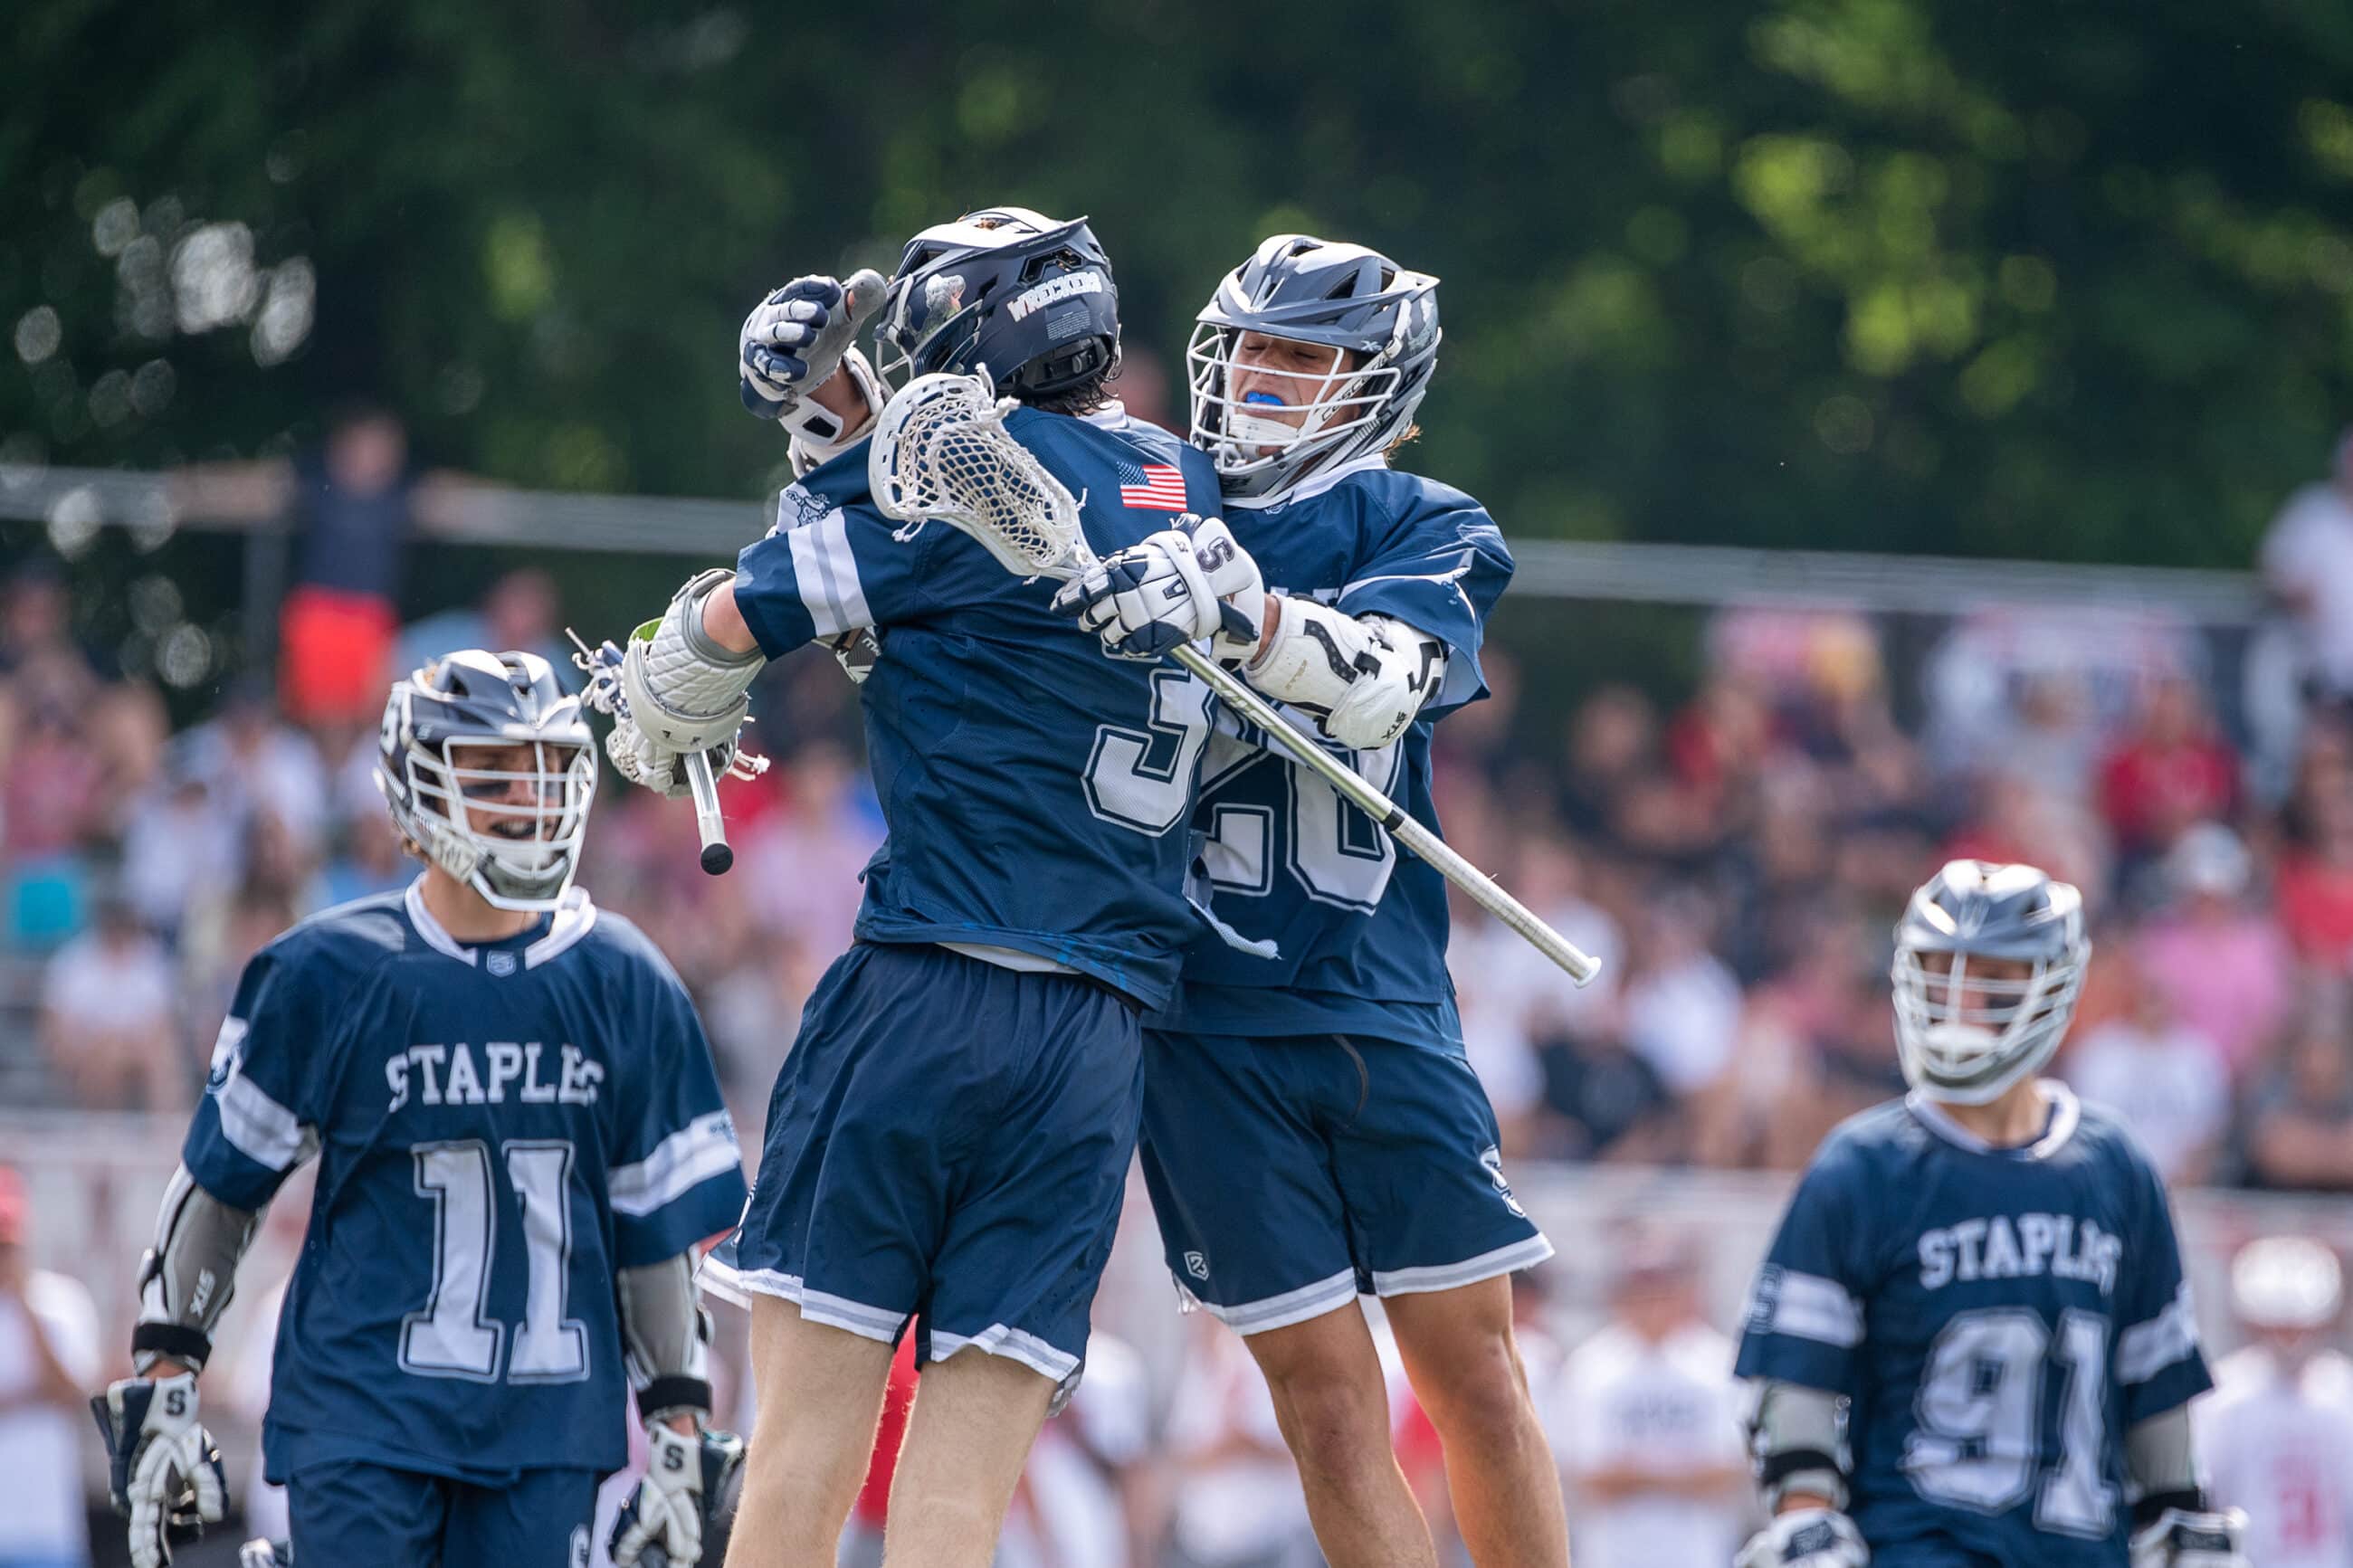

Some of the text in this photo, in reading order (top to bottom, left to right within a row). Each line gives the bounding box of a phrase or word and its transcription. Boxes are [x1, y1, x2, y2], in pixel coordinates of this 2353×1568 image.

[1006, 271, 1102, 323] WRECKERS
[1191, 689, 1405, 917] 20
[385, 1041, 605, 1113] STAPLES
[396, 1138, 591, 1384] 11
[165, 1389, 186, 1417] S
[1896, 1306, 2122, 1541] 91
